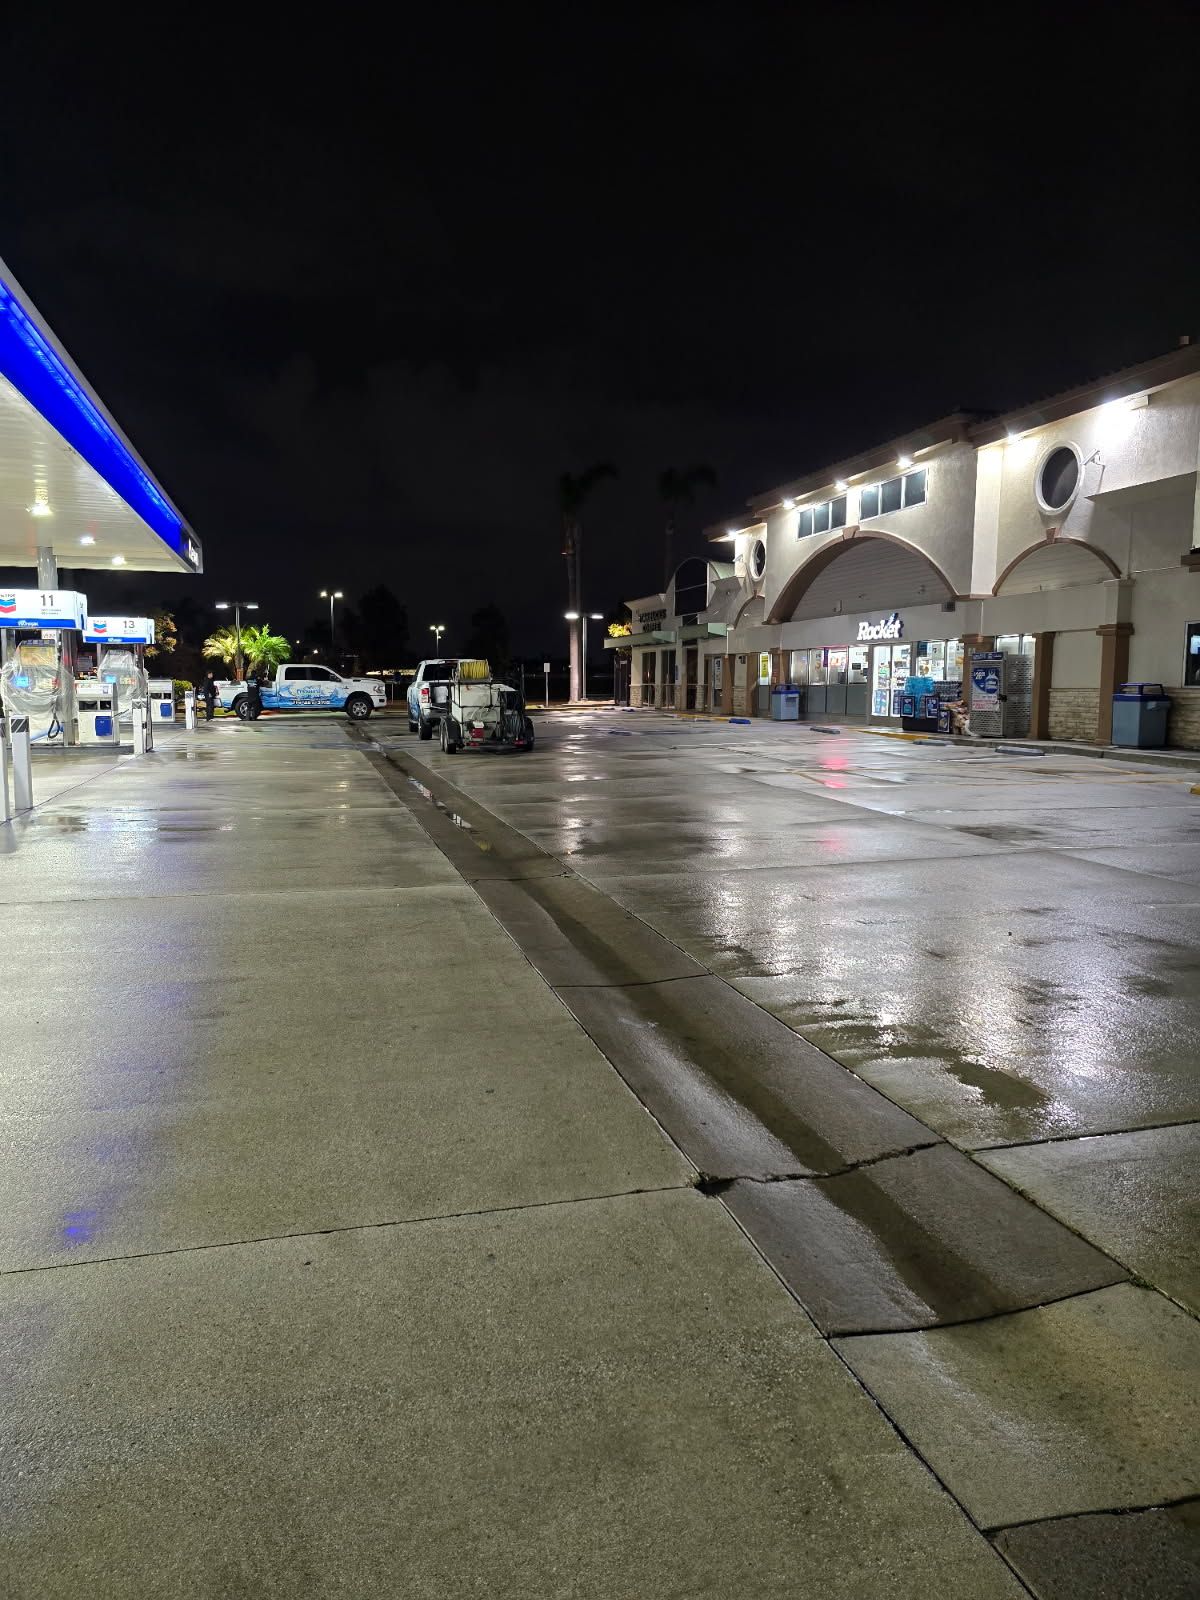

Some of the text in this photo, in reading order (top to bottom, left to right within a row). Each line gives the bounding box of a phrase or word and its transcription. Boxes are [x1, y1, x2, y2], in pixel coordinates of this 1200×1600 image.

[40, 593, 54, 607] 11
[122, 620, 135, 629] 13
[856, 612, 901, 641] Rocket
